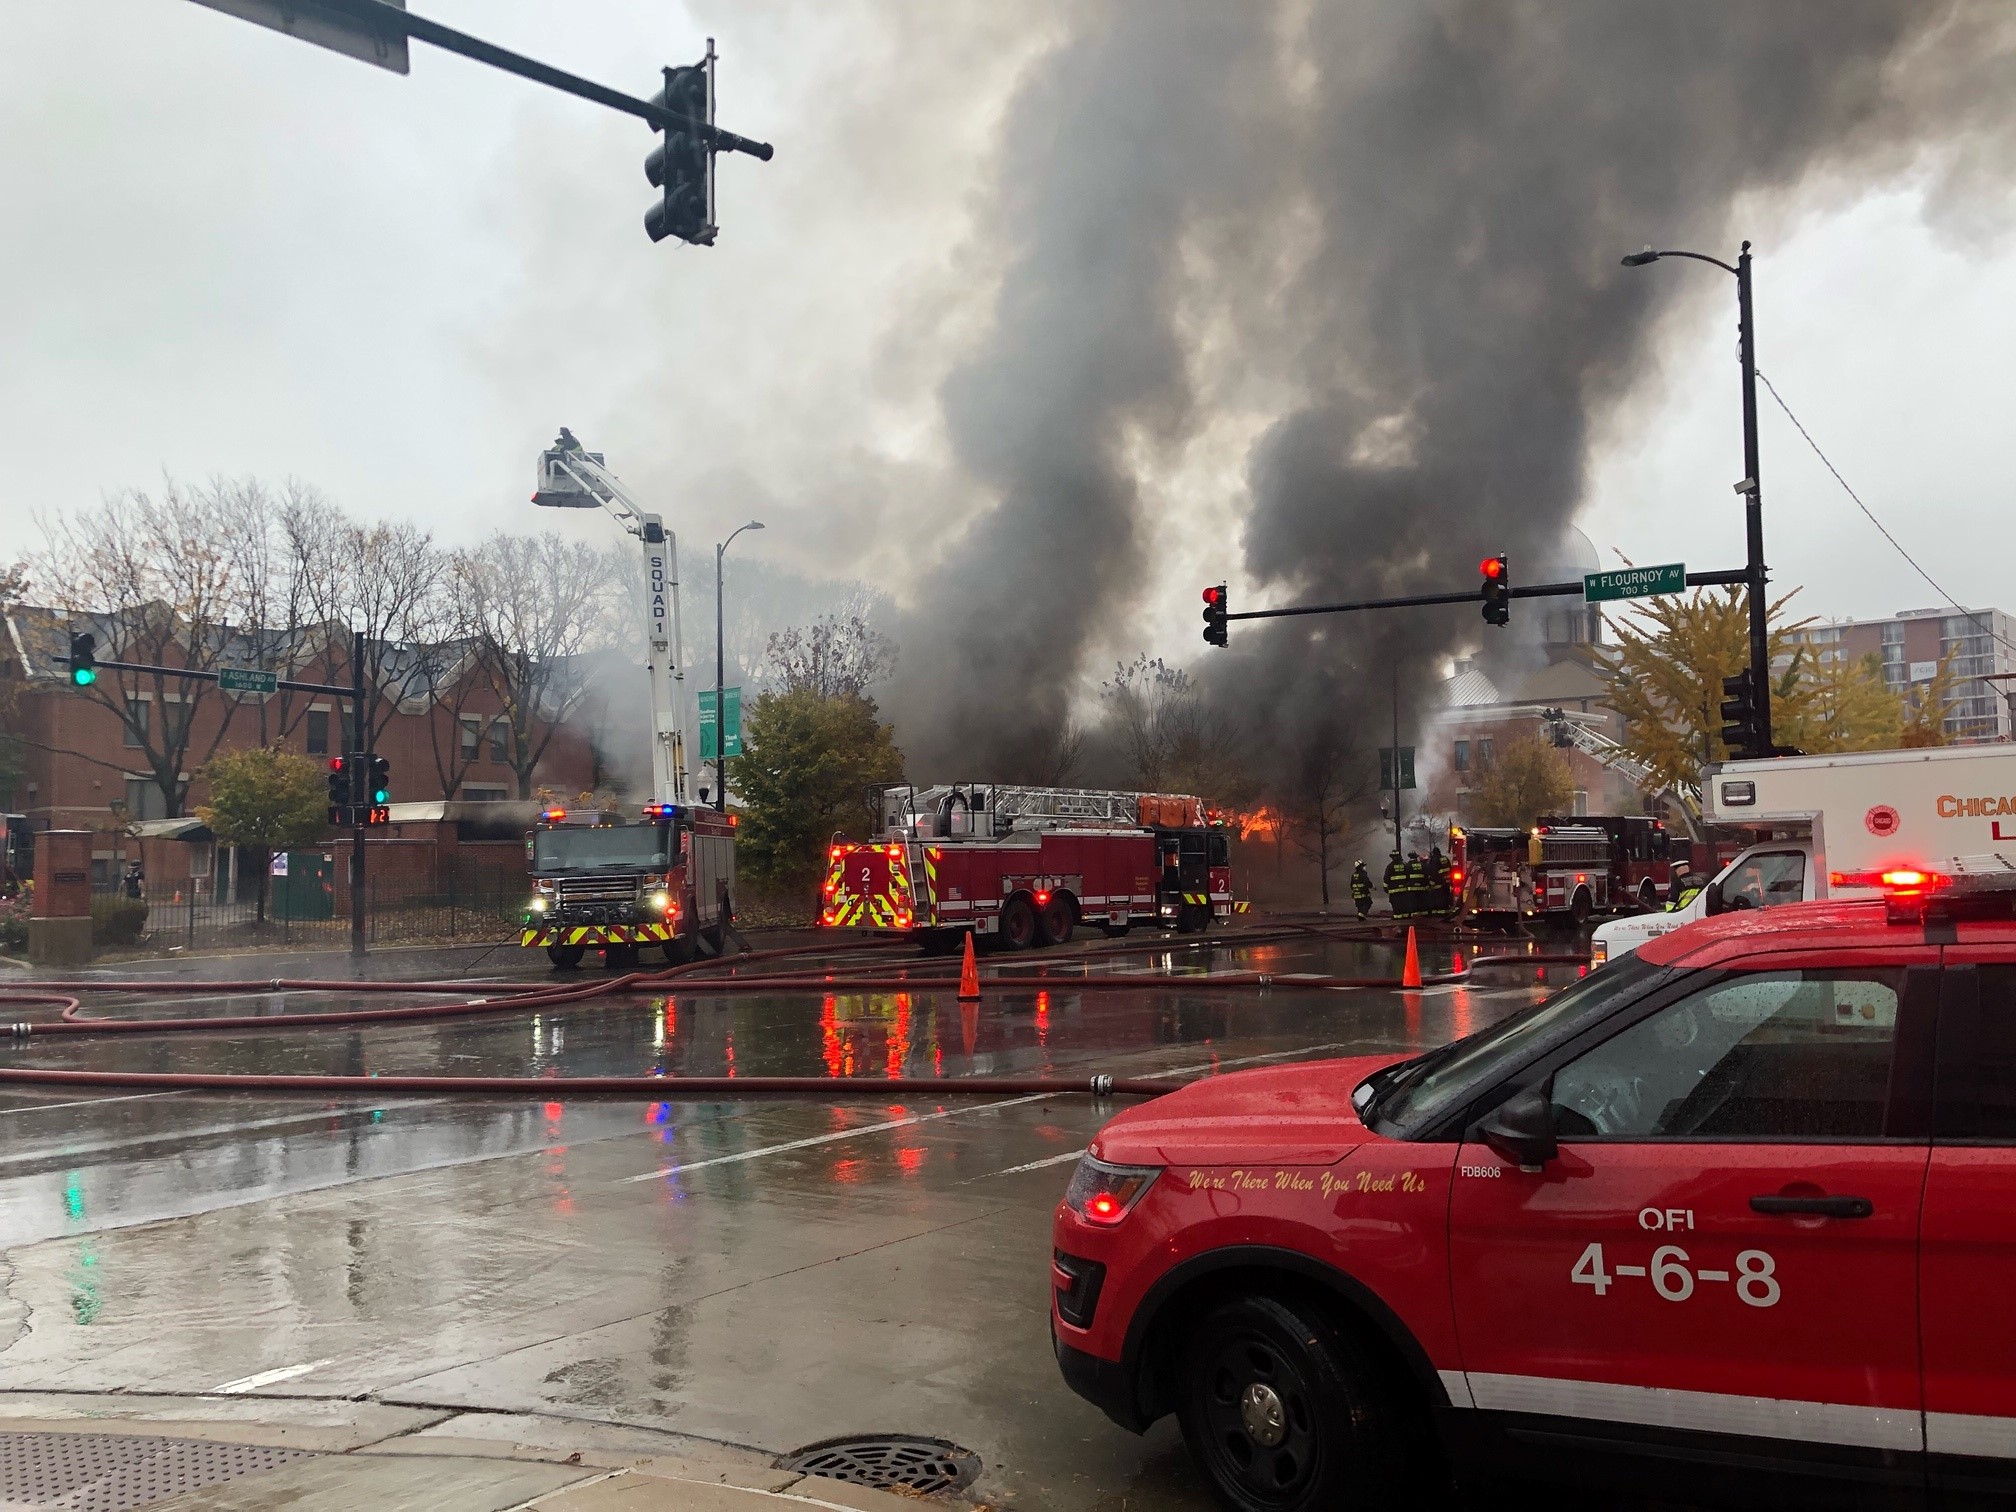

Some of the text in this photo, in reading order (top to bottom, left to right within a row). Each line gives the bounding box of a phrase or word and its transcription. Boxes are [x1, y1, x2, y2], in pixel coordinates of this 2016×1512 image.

[1589, 569, 1680, 588] W FLOURNOY AV
[651, 556, 665, 633] SQUAD 1
[1620, 585, 1649, 595] 700 S
[228, 671, 266, 683] ASHLAND
[861, 867, 870, 881] 2
[1218, 878, 1225, 892] 2
[1461, 1165, 1501, 1178] FDB606
[1189, 1169, 1426, 1200] We're There When You Need Us
[1638, 1207, 1695, 1231] OFI
[1570, 1242, 1781, 1307] 4-6-8
